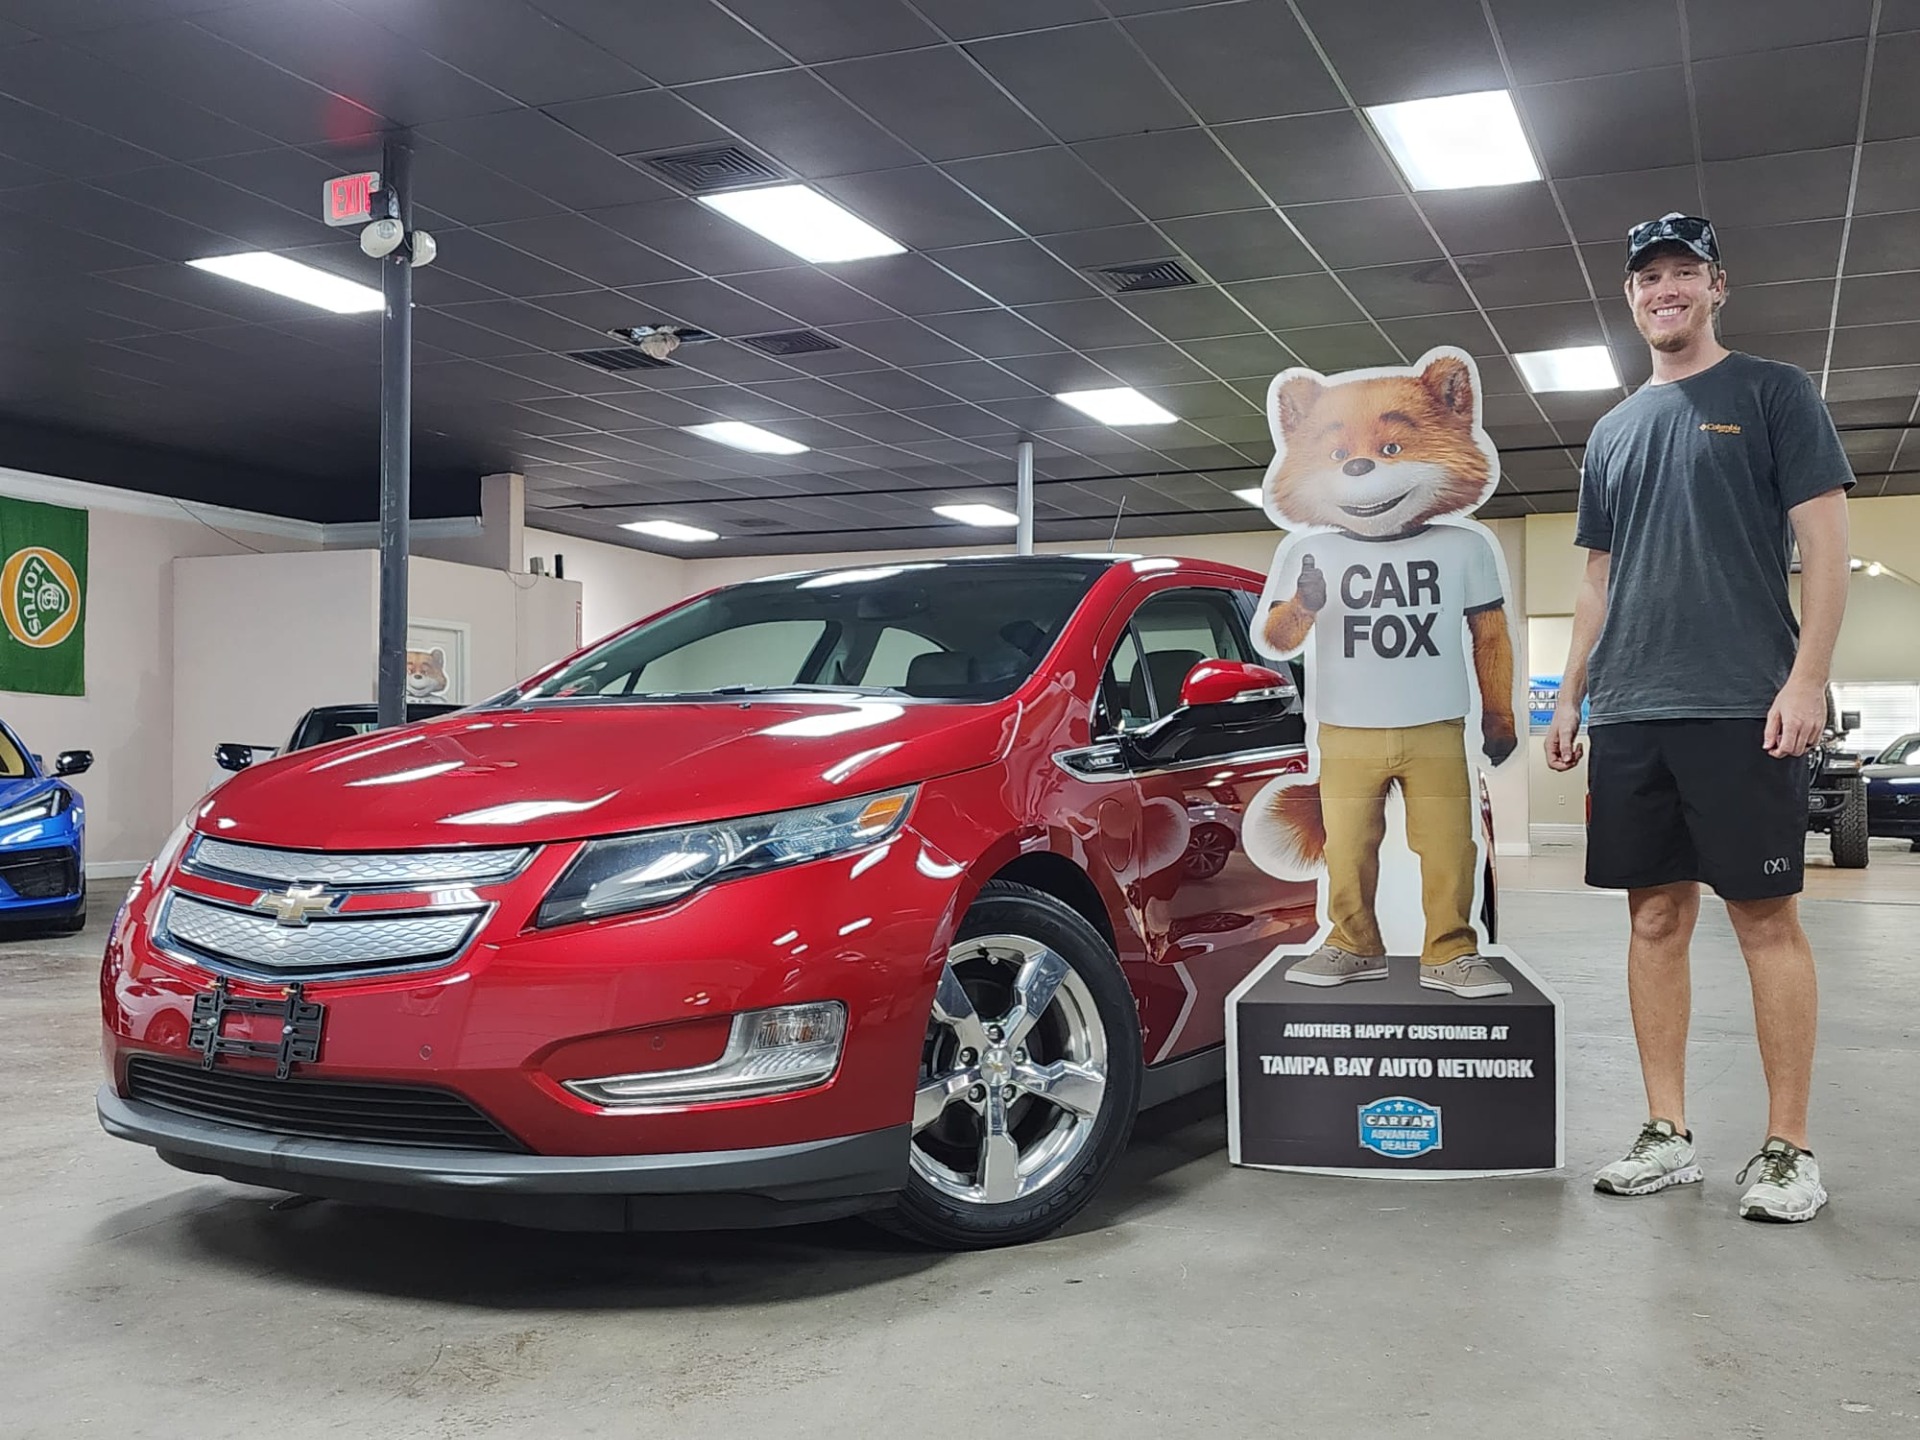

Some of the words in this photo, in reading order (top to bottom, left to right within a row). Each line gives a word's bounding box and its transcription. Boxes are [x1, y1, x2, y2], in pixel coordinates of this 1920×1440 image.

[332, 174, 372, 219] EXIT
[1340, 560, 1441, 609] CAR
[22, 559, 45, 634] LOTUS
[1343, 612, 1441, 659] FOX
[1088, 756, 1114, 767] VOLT
[1283, 1023, 1352, 1039] ANOTHER
[1354, 1024, 1405, 1039] HAPPY
[1407, 1025, 1488, 1040] CUSTOMER
[1490, 1026, 1510, 1040] AT
[1259, 1055, 1330, 1076] TAMPA
[1333, 1057, 1375, 1077] BAY
[1378, 1058, 1434, 1078] AUTO
[1437, 1059, 1535, 1078] NETWORK
[1366, 1115, 1435, 1128] CARFAX
[1371, 1129, 1430, 1140] ADVANTAGE
[1380, 1141, 1421, 1150] DEALER
